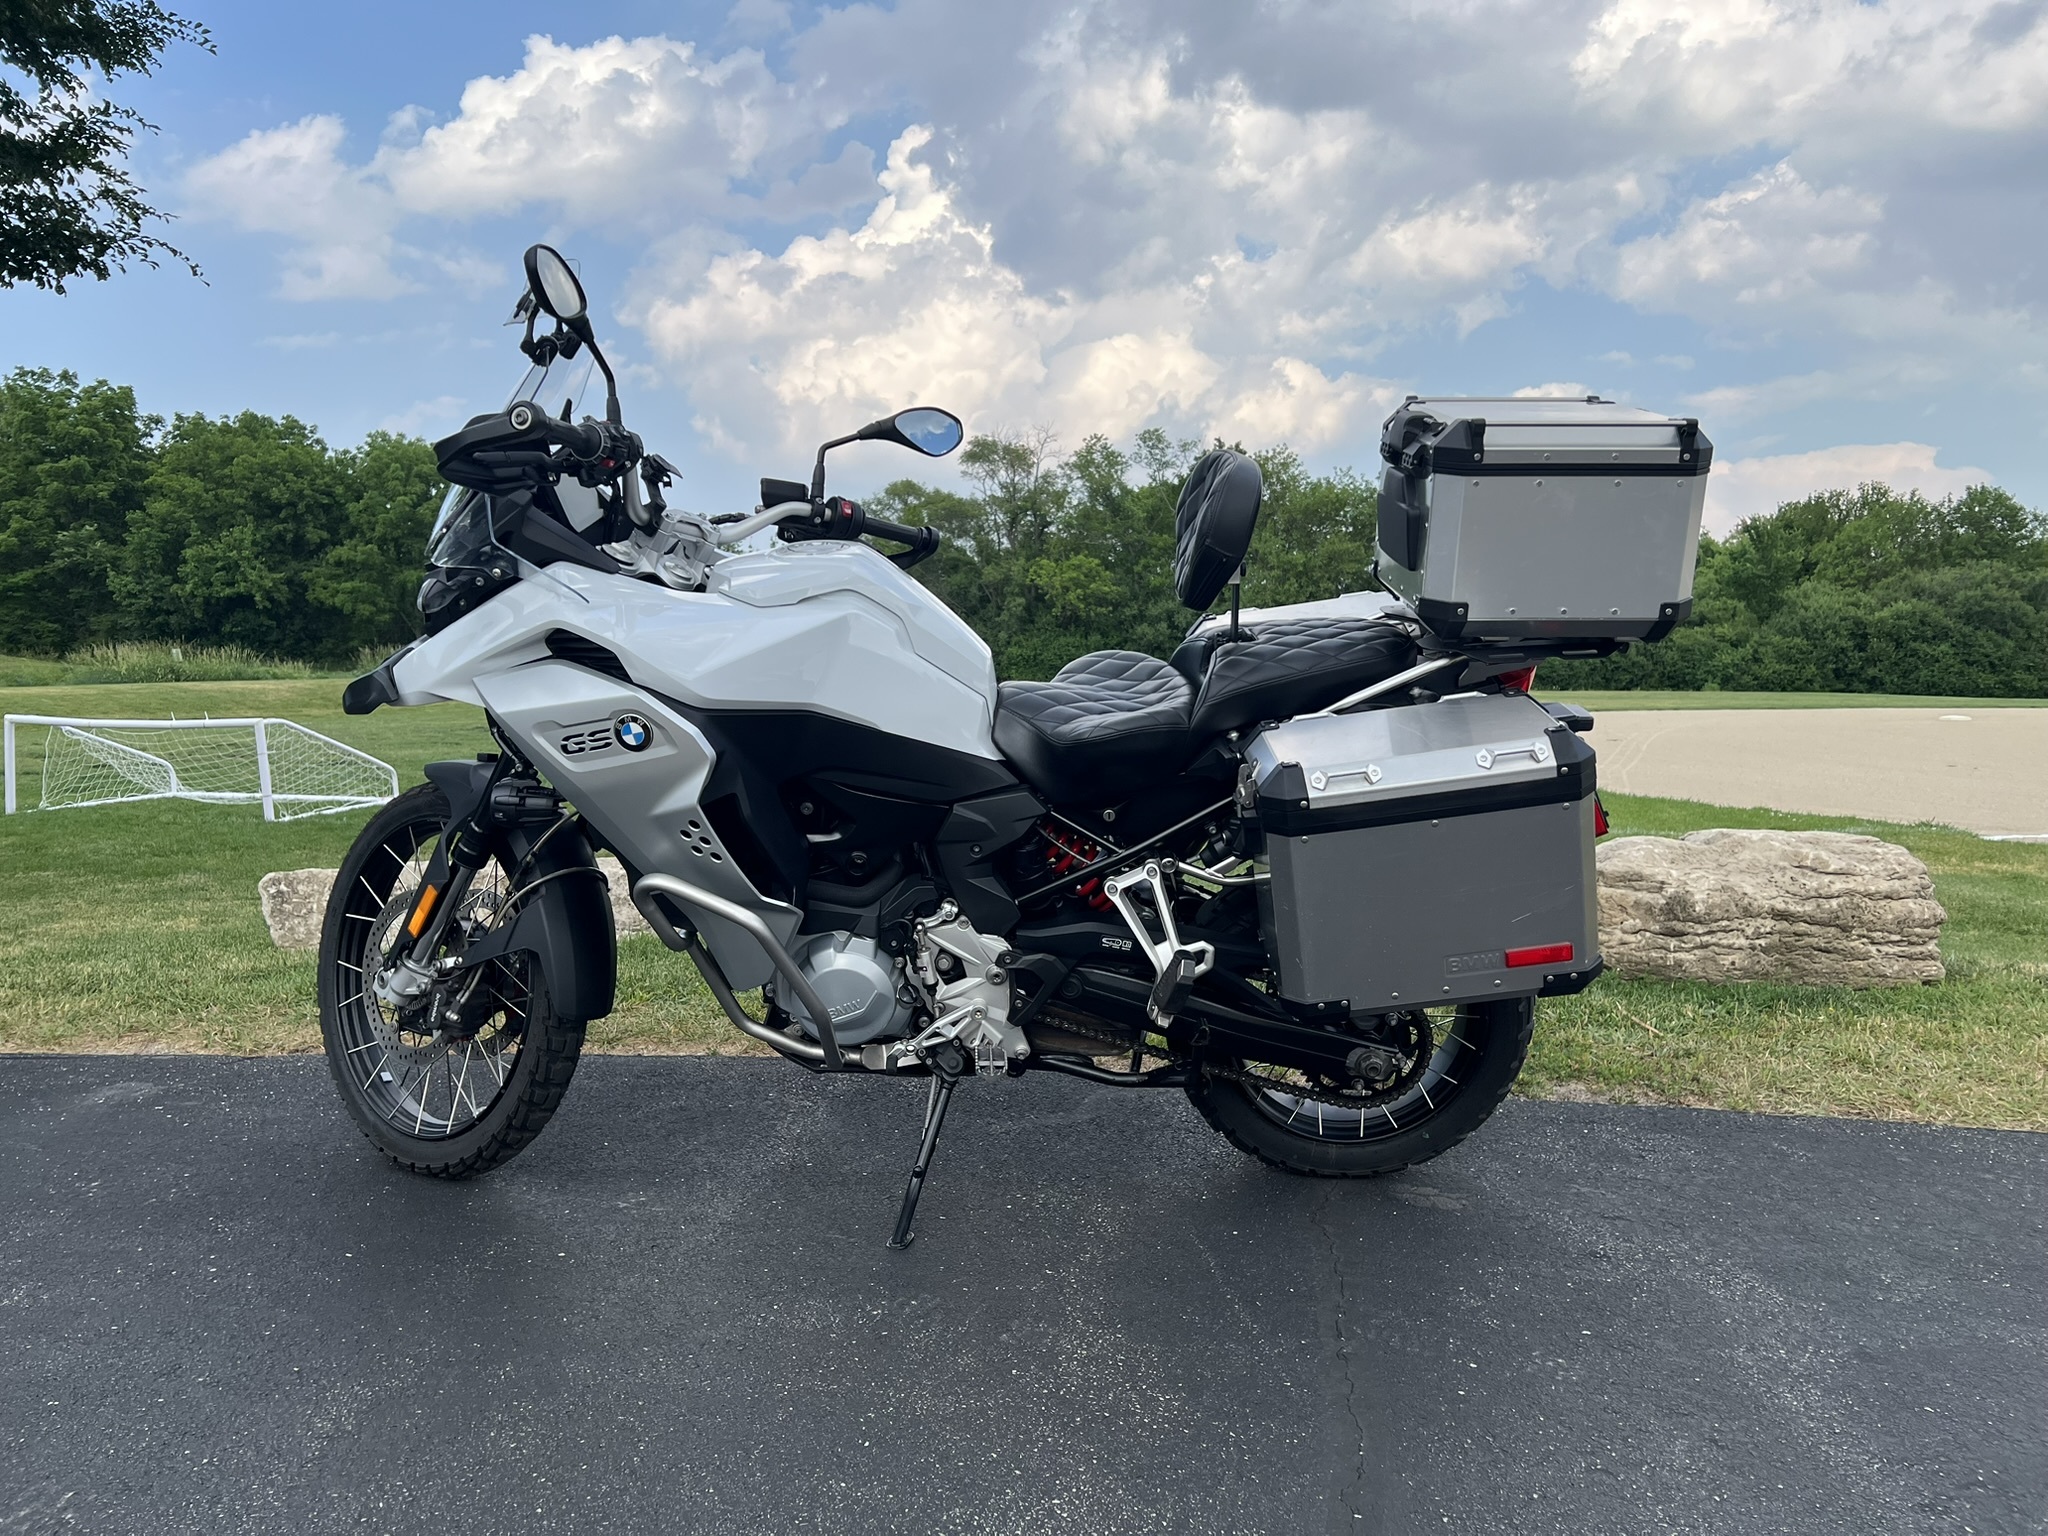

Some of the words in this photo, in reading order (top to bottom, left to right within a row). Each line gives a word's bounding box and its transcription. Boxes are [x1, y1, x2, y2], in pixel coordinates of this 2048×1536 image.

[560, 727, 613, 756] GS
[1449, 952, 1500, 972] BMW
[828, 998, 861, 1019] BMW
